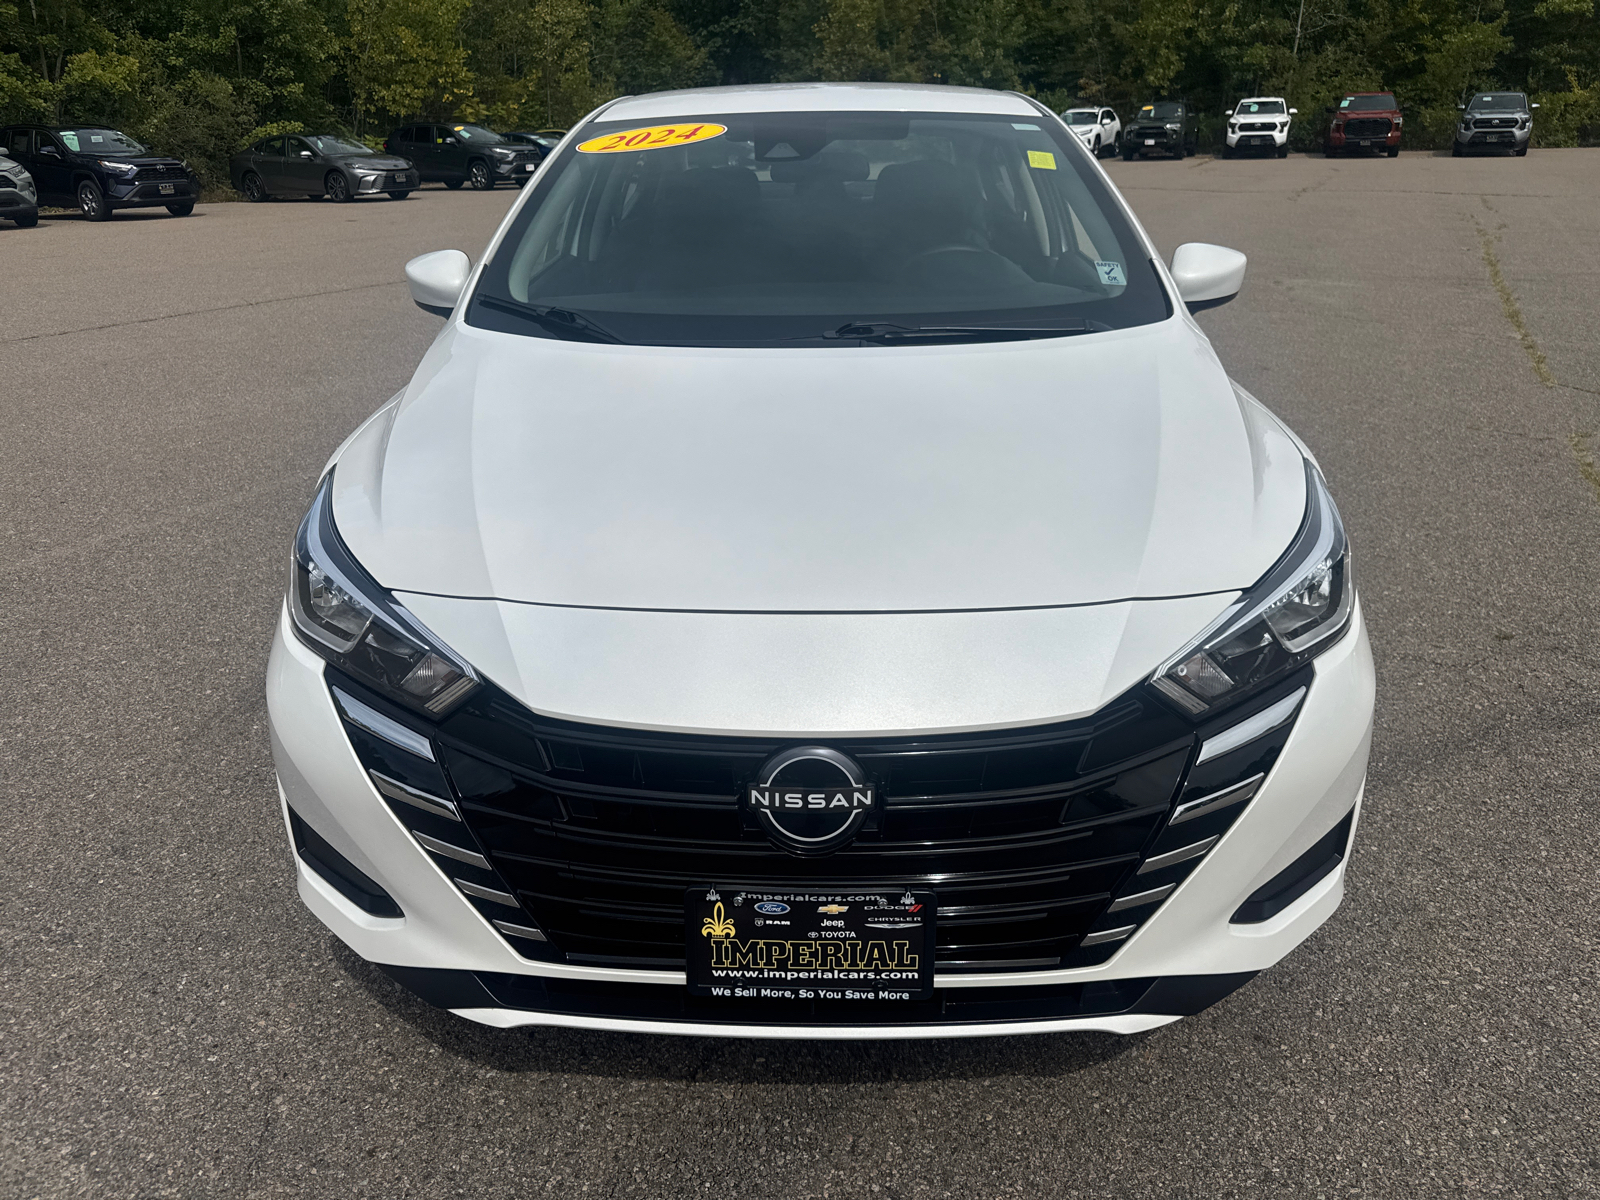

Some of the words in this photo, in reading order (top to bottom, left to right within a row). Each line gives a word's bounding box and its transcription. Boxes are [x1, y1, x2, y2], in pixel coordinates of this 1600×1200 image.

[598, 126, 704, 151] 2024
[751, 790, 872, 808] NISSAN
[740, 892, 881, 902] Imperialcars.com
[762, 903, 783, 912] Ford
[820, 919, 845, 928] Jeep
[711, 938, 919, 970] IMPERIAL
[711, 969, 919, 980] www.imperialcars.com
[711, 987, 731, 996] We
[734, 988, 757, 997] Sell
[761, 989, 795, 999] More,
[799, 990, 814, 998] So
[818, 990, 842, 999] You
[845, 990, 875, 999] Save
[879, 991, 910, 1000] More
